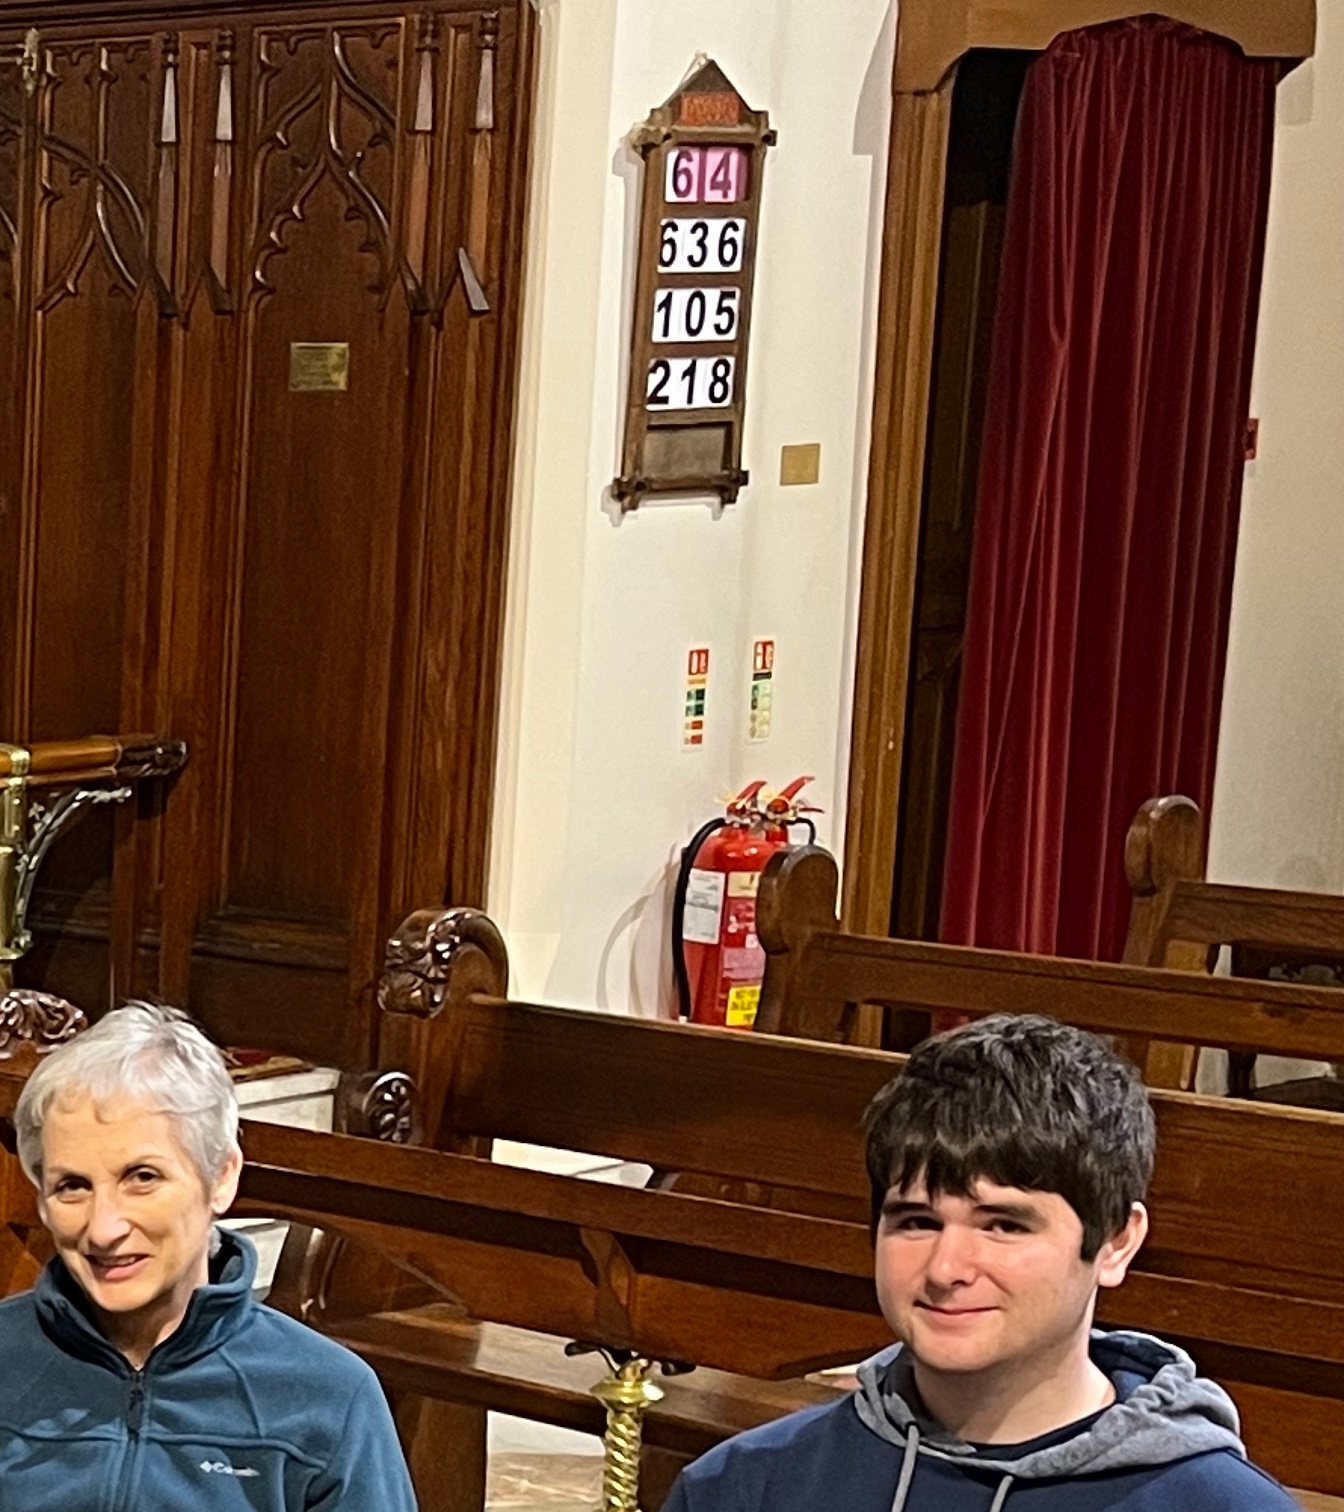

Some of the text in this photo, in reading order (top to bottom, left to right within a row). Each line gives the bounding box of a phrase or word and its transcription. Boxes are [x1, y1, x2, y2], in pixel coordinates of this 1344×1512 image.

[660, 220, 739, 267] 636
[656, 290, 736, 338] 105
[647, 358, 731, 405] 218
